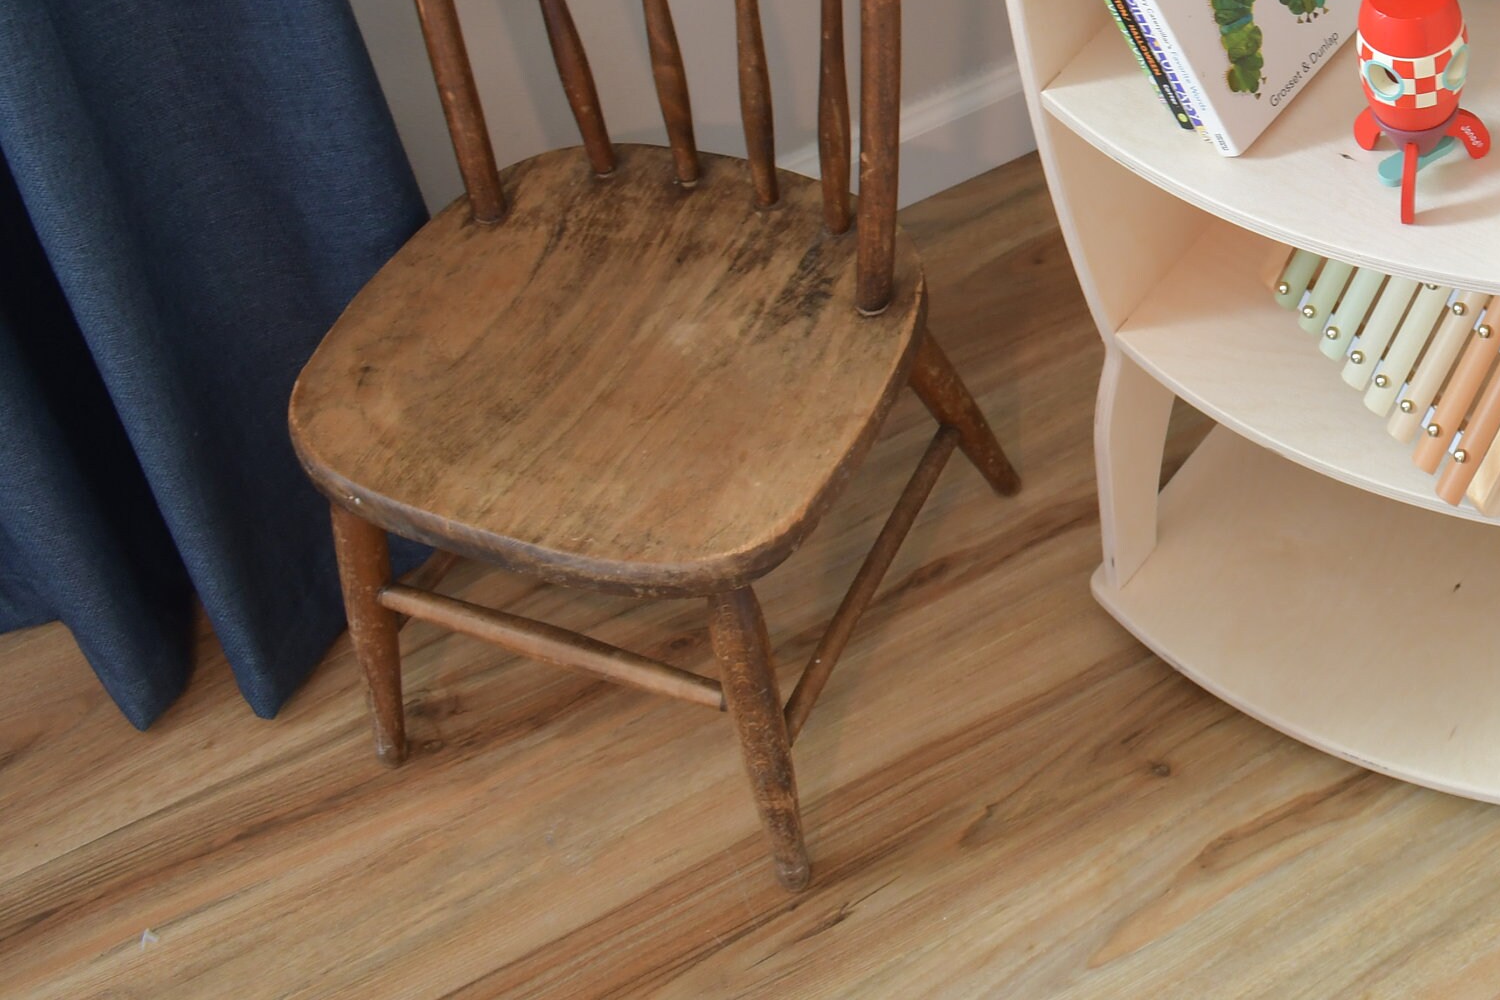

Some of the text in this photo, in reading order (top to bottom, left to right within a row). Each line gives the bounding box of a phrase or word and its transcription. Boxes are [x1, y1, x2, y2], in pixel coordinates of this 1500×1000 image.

[1127, 23, 1162, 77] HALLOWEEN
[1268, 32, 1339, 108] Grosset & Dunlap
